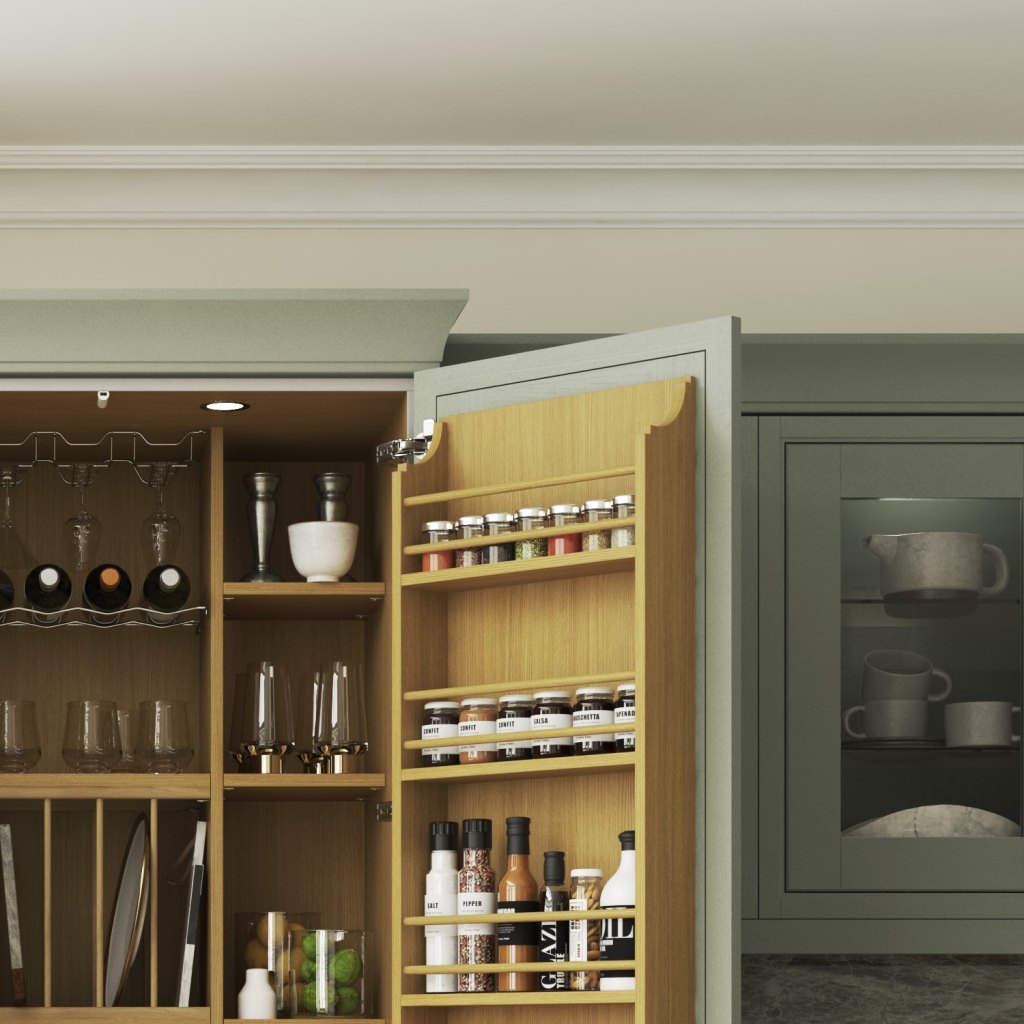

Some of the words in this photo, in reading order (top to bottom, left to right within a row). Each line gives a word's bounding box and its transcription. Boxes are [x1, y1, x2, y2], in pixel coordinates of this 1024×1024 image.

[573, 713, 600, 721] USCHETTA
[616, 710, 635, 718] APENAD
[533, 717, 549, 725] SALSA
[423, 727, 440, 735] CONFIT
[460, 724, 477, 732] CONFIT
[556, 953, 565, 989] TRULE
